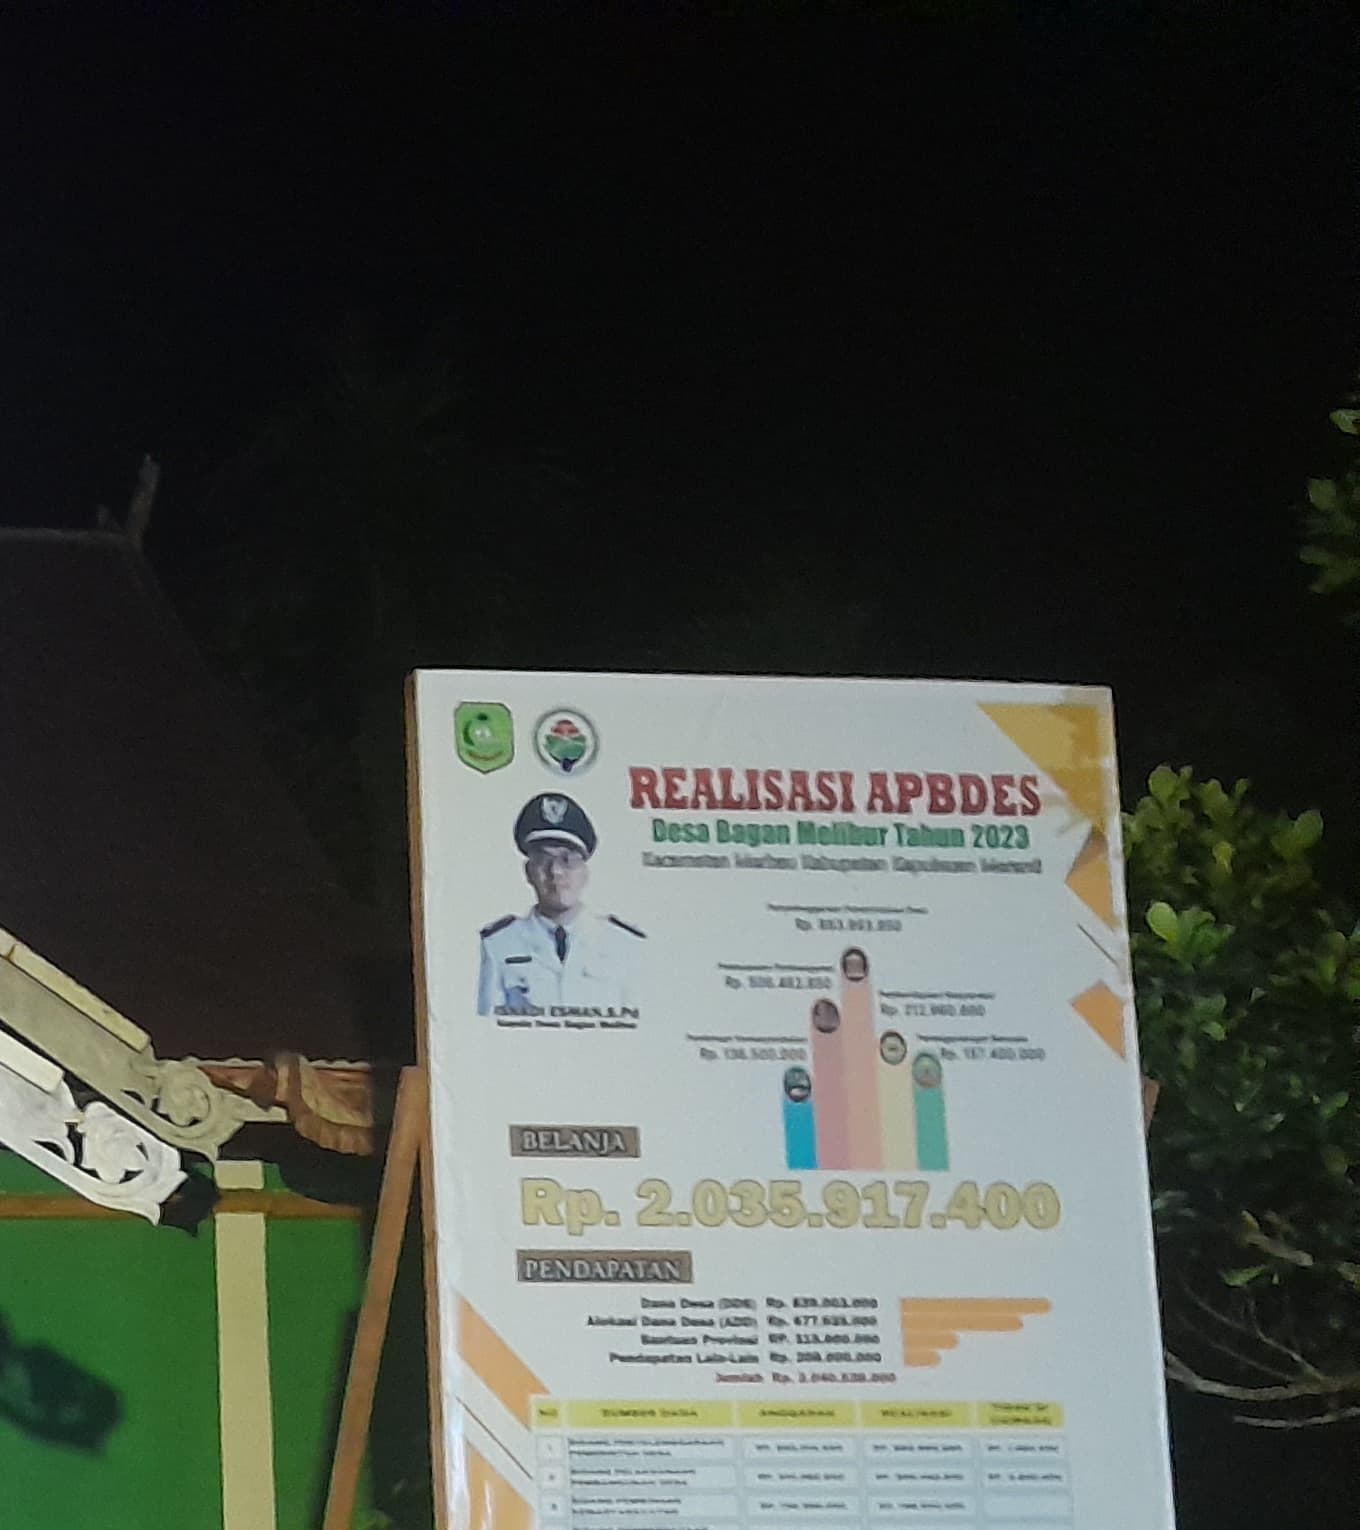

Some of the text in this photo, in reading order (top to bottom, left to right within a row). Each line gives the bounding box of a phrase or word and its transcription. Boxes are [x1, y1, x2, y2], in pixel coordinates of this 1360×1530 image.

[629, 766, 1042, 817] REALISASI APBDES
[972, 824, 1030, 849] 2023
[521, 1129, 626, 1153] BELANJA
[519, 1178, 1061, 1236] Rp. 2.035.917.400
[522, 1258, 682, 1282] PENDAPATAN
